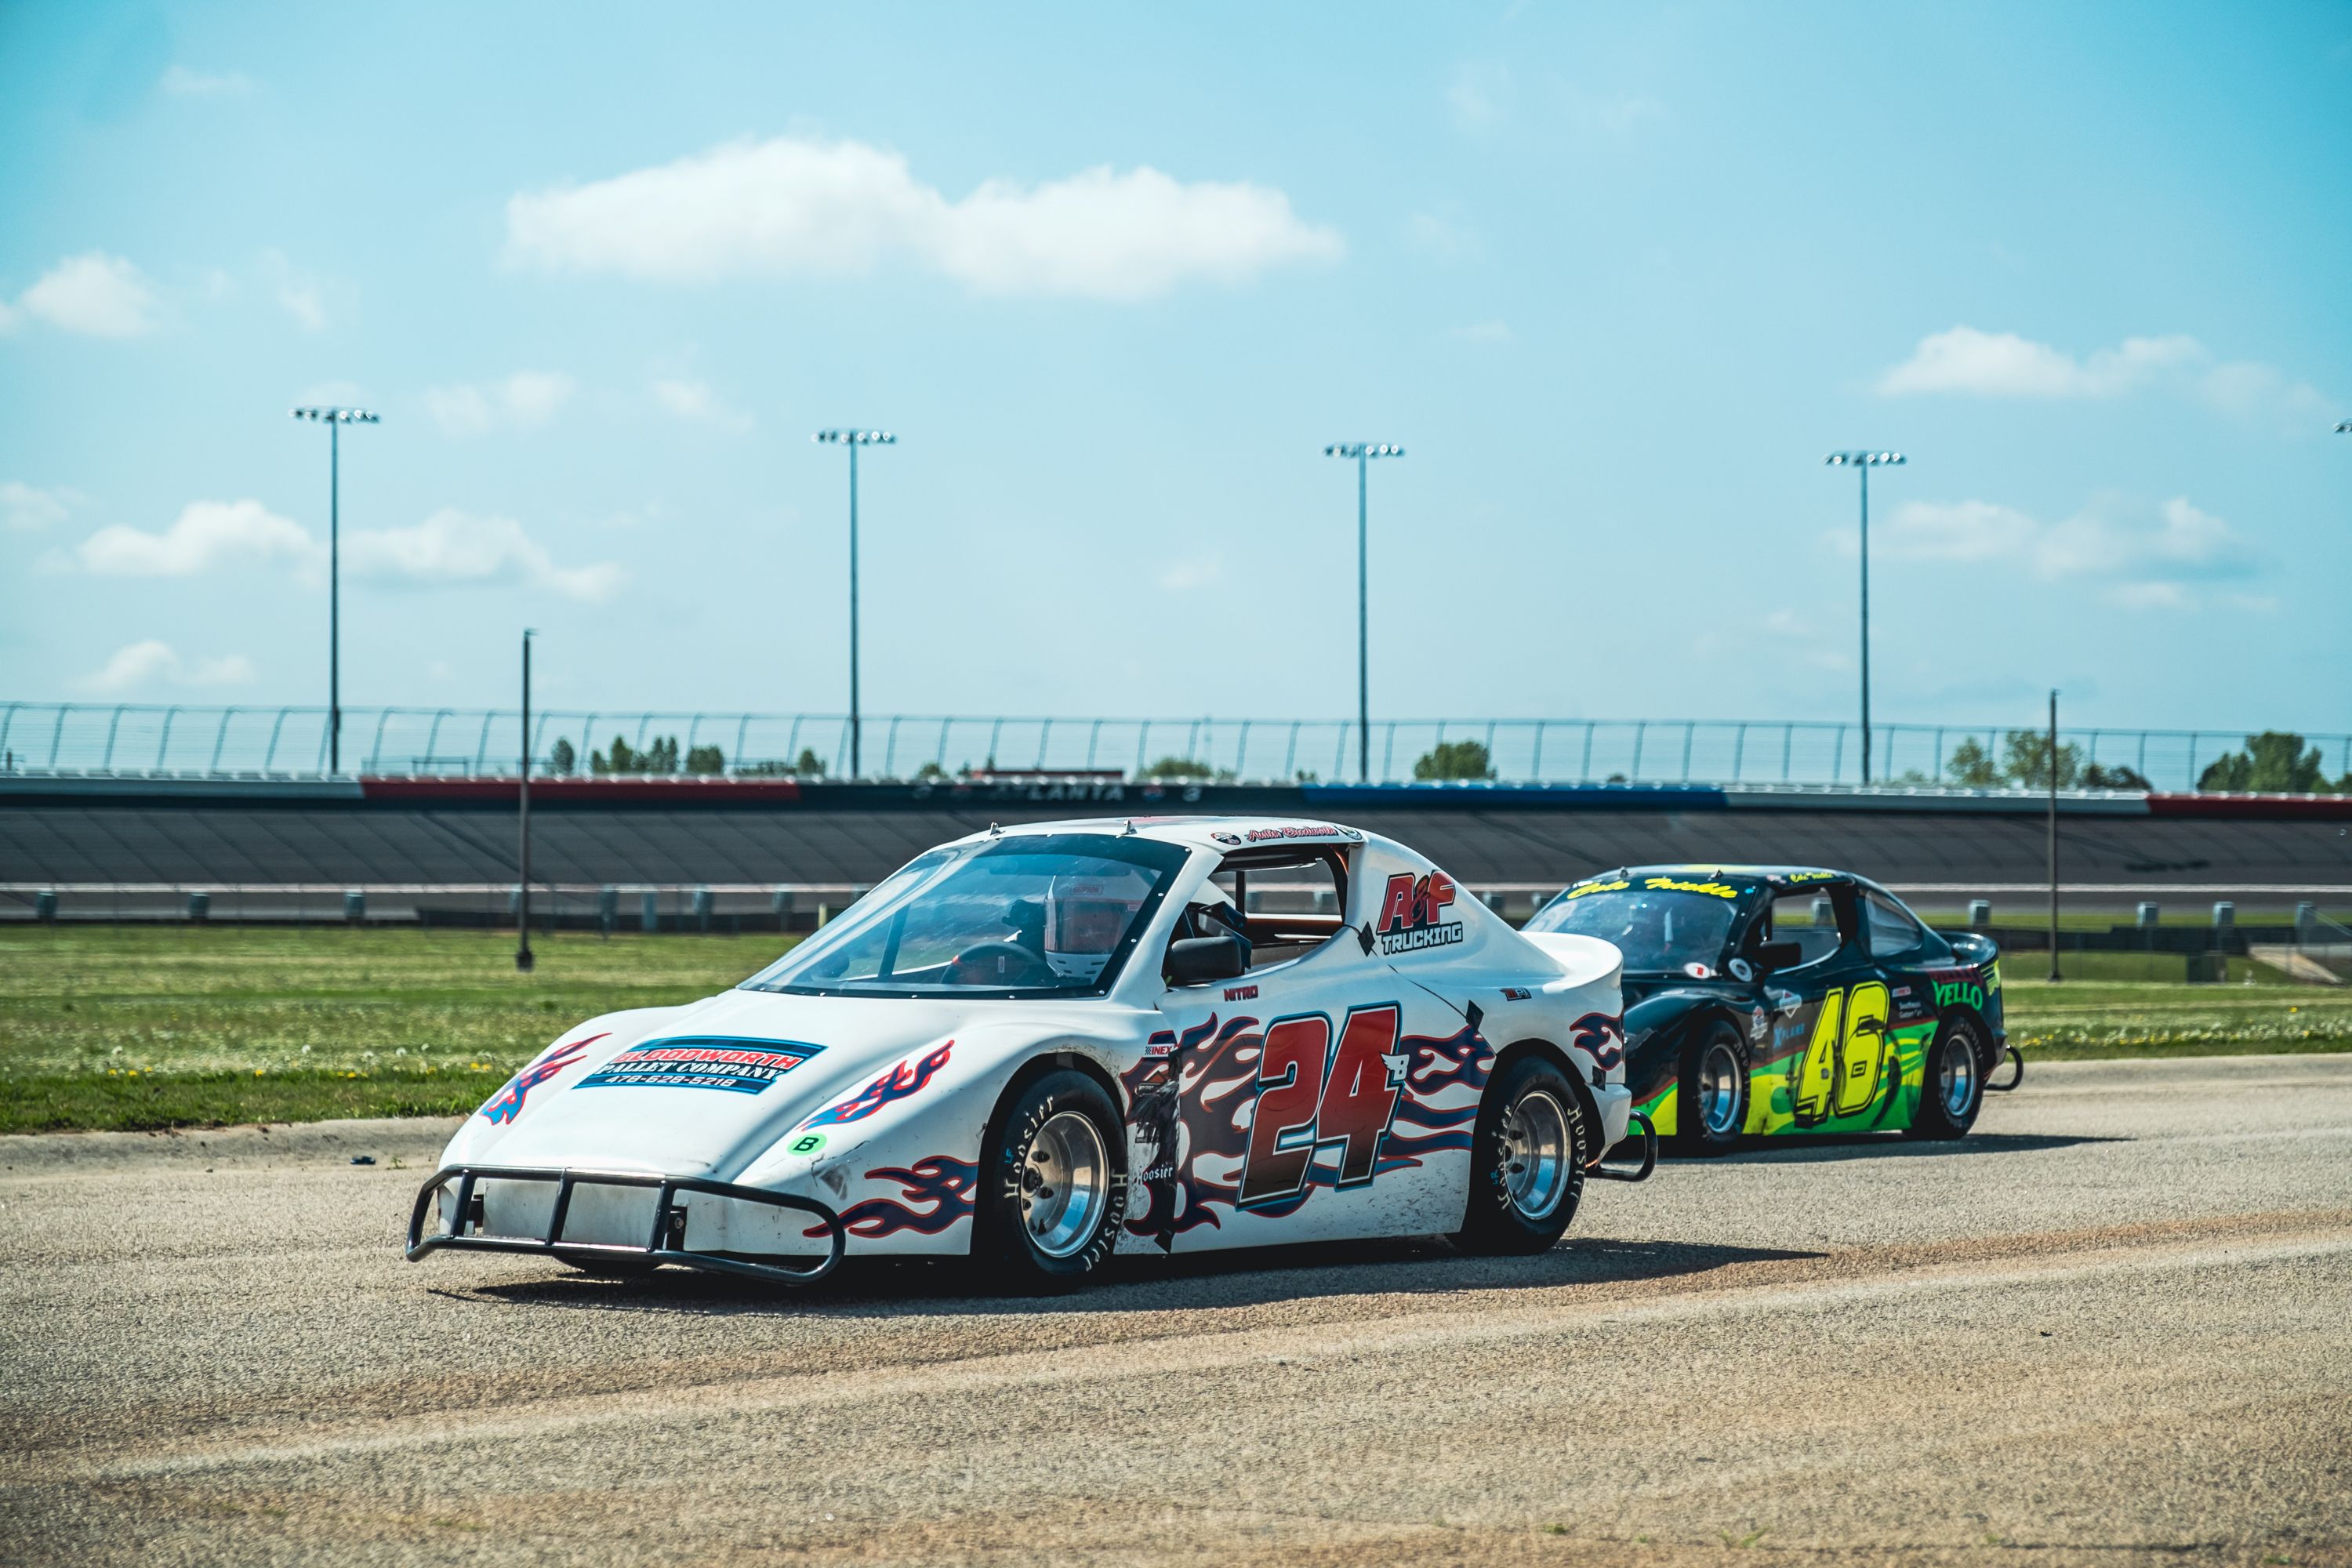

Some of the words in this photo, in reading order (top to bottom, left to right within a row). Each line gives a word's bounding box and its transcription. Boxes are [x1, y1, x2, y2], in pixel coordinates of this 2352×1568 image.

[1381, 922, 1463, 955] TRUCKING
[1224, 985, 1258, 1002] NITRO
[1932, 980, 1983, 1011] YELLO
[610, 1048, 804, 1070] BLOODWORTH
[1152, 1046, 1172, 1055] INEX
[1794, 981, 1890, 1127] 46
[594, 1062, 677, 1075] PALLET
[676, 1062, 784, 1080] COMPANY
[1236, 1000, 1404, 1211] 24
[793, 1137, 819, 1151] B
[1132, 1163, 1173, 1185] Hoosier
